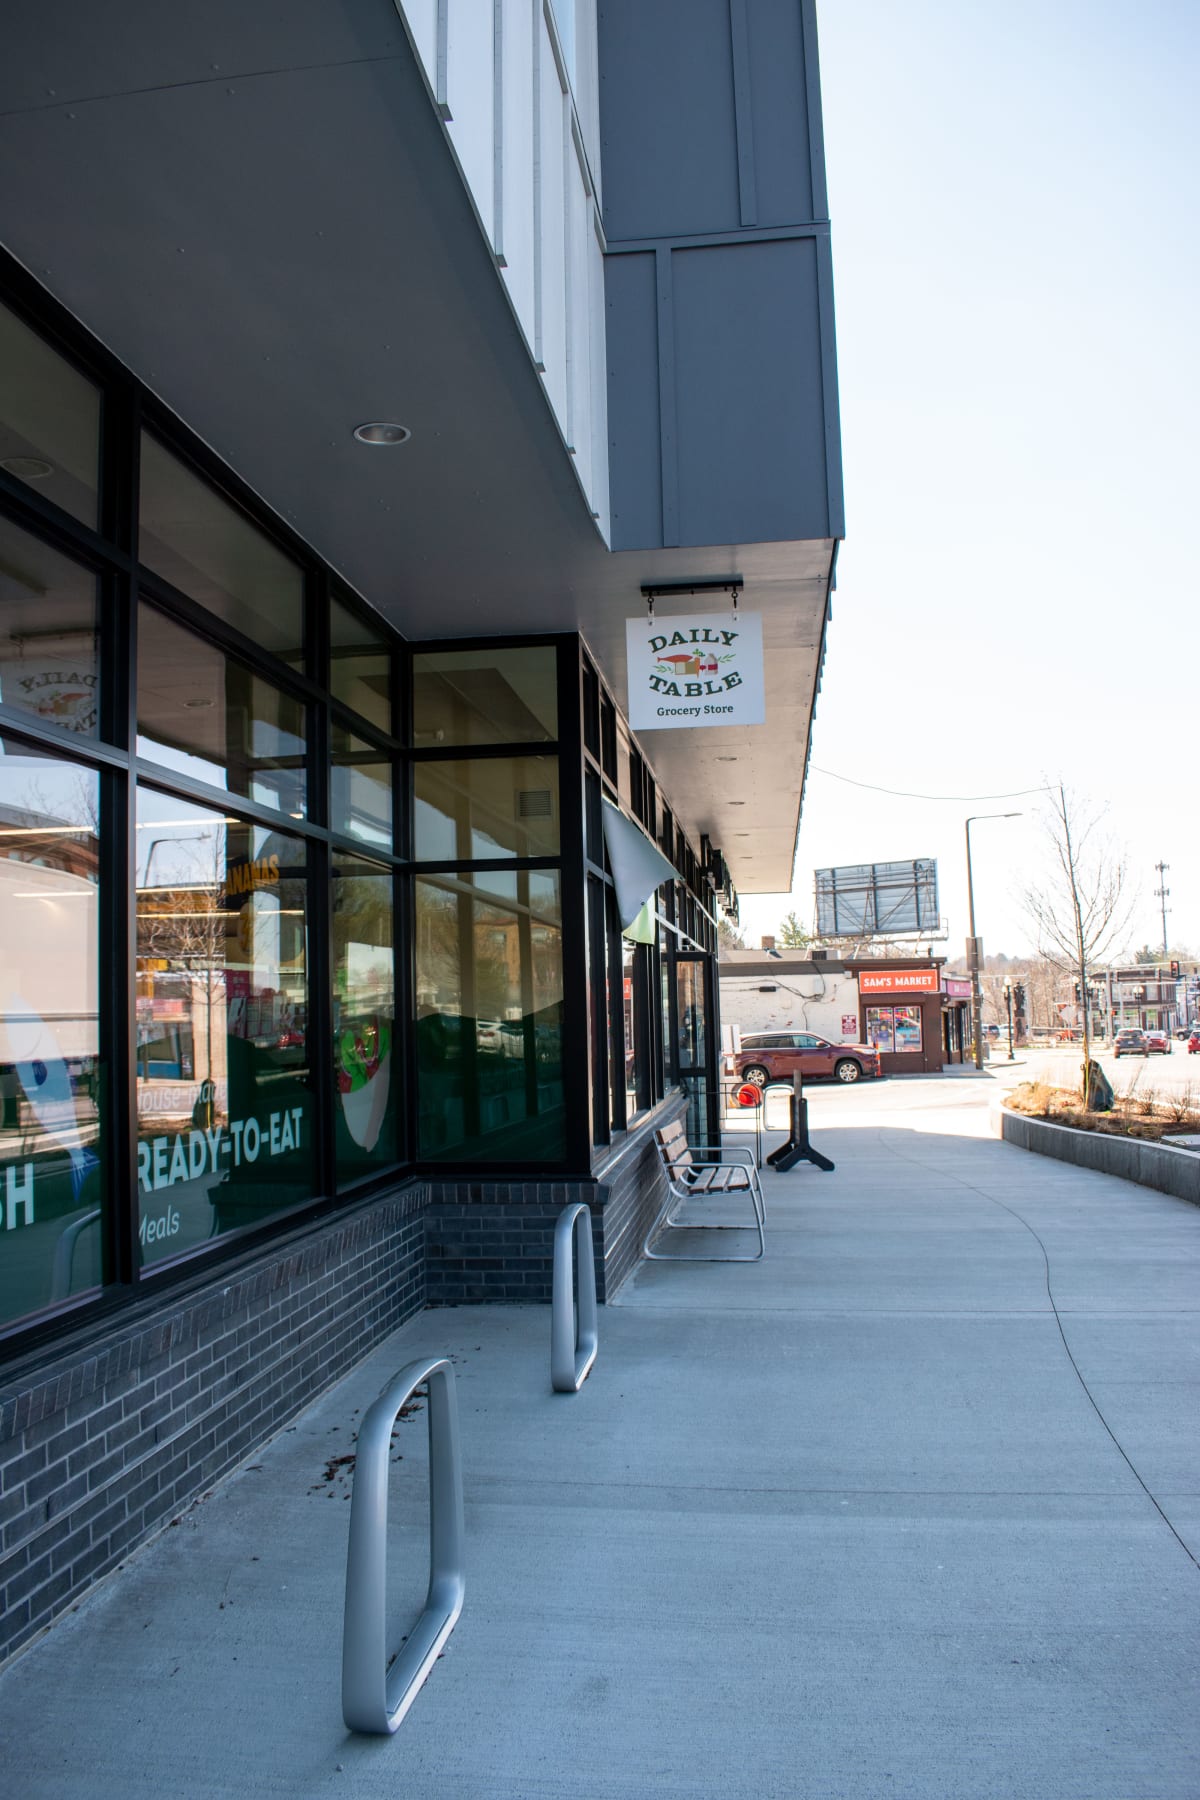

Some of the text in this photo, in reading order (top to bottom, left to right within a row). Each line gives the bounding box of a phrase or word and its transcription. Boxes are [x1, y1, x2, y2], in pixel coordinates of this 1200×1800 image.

[648, 628, 739, 654] DAILY
[649, 671, 743, 697] TABLE
[657, 704, 734, 717] Grocery Store
[226, 854, 279, 895] ANANAS
[864, 976, 933, 987] SAM'S MARKET
[137, 1107, 303, 1192] READY-TO-EAT
[0, 1162, 35, 1231] H
